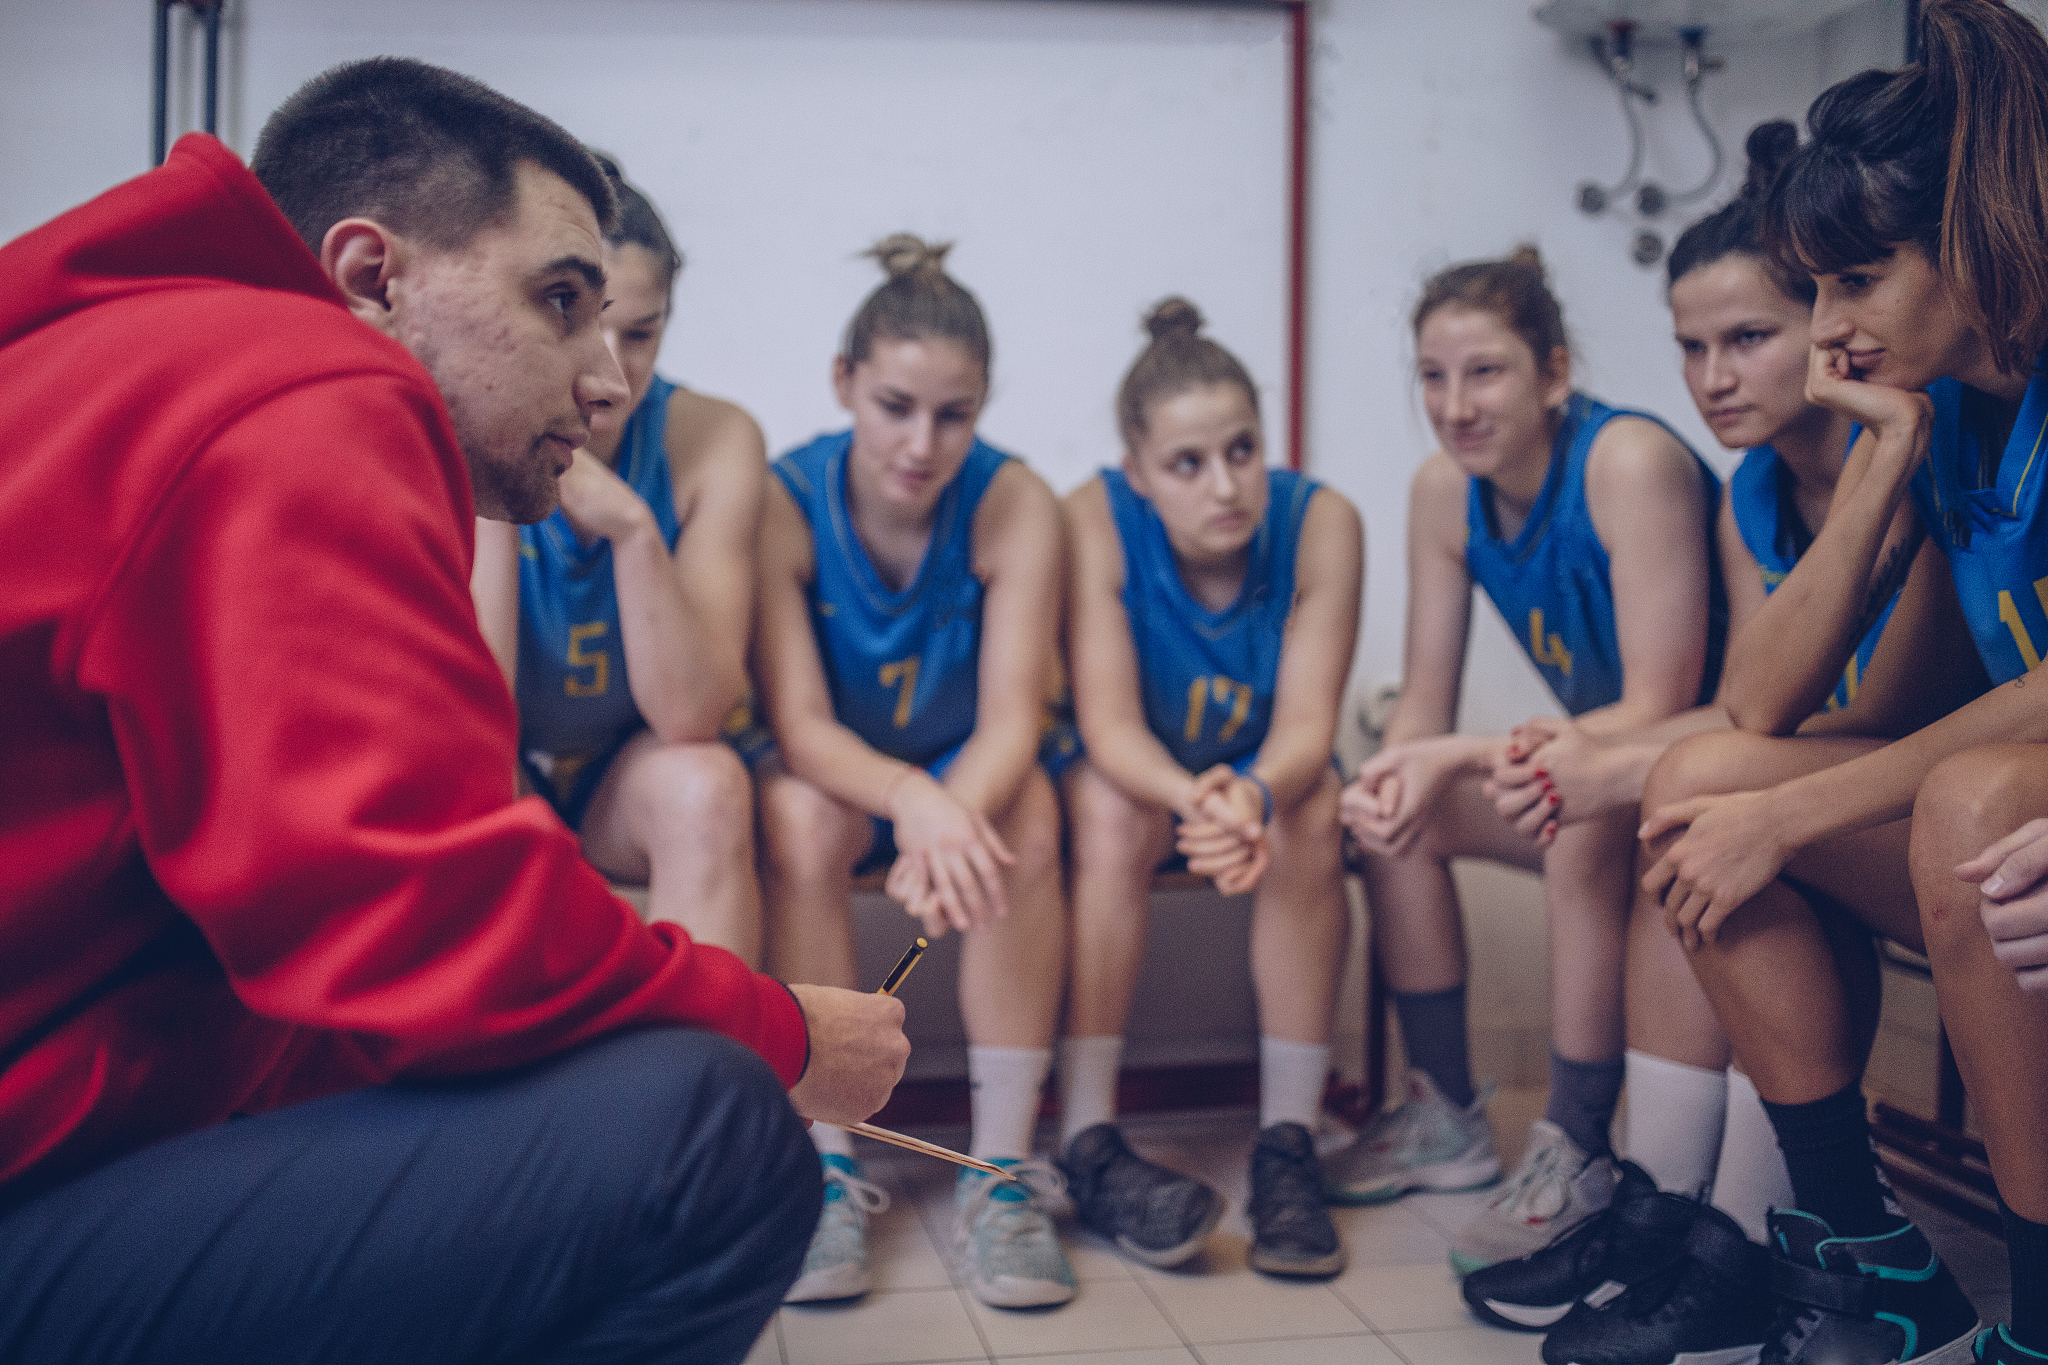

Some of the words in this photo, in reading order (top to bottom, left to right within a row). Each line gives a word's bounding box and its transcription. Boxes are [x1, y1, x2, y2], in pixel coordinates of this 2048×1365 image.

[565, 621, 609, 697] 5
[1529, 607, 1573, 676] 4
[878, 655, 921, 728] 7
[1185, 674, 1252, 742] 17
